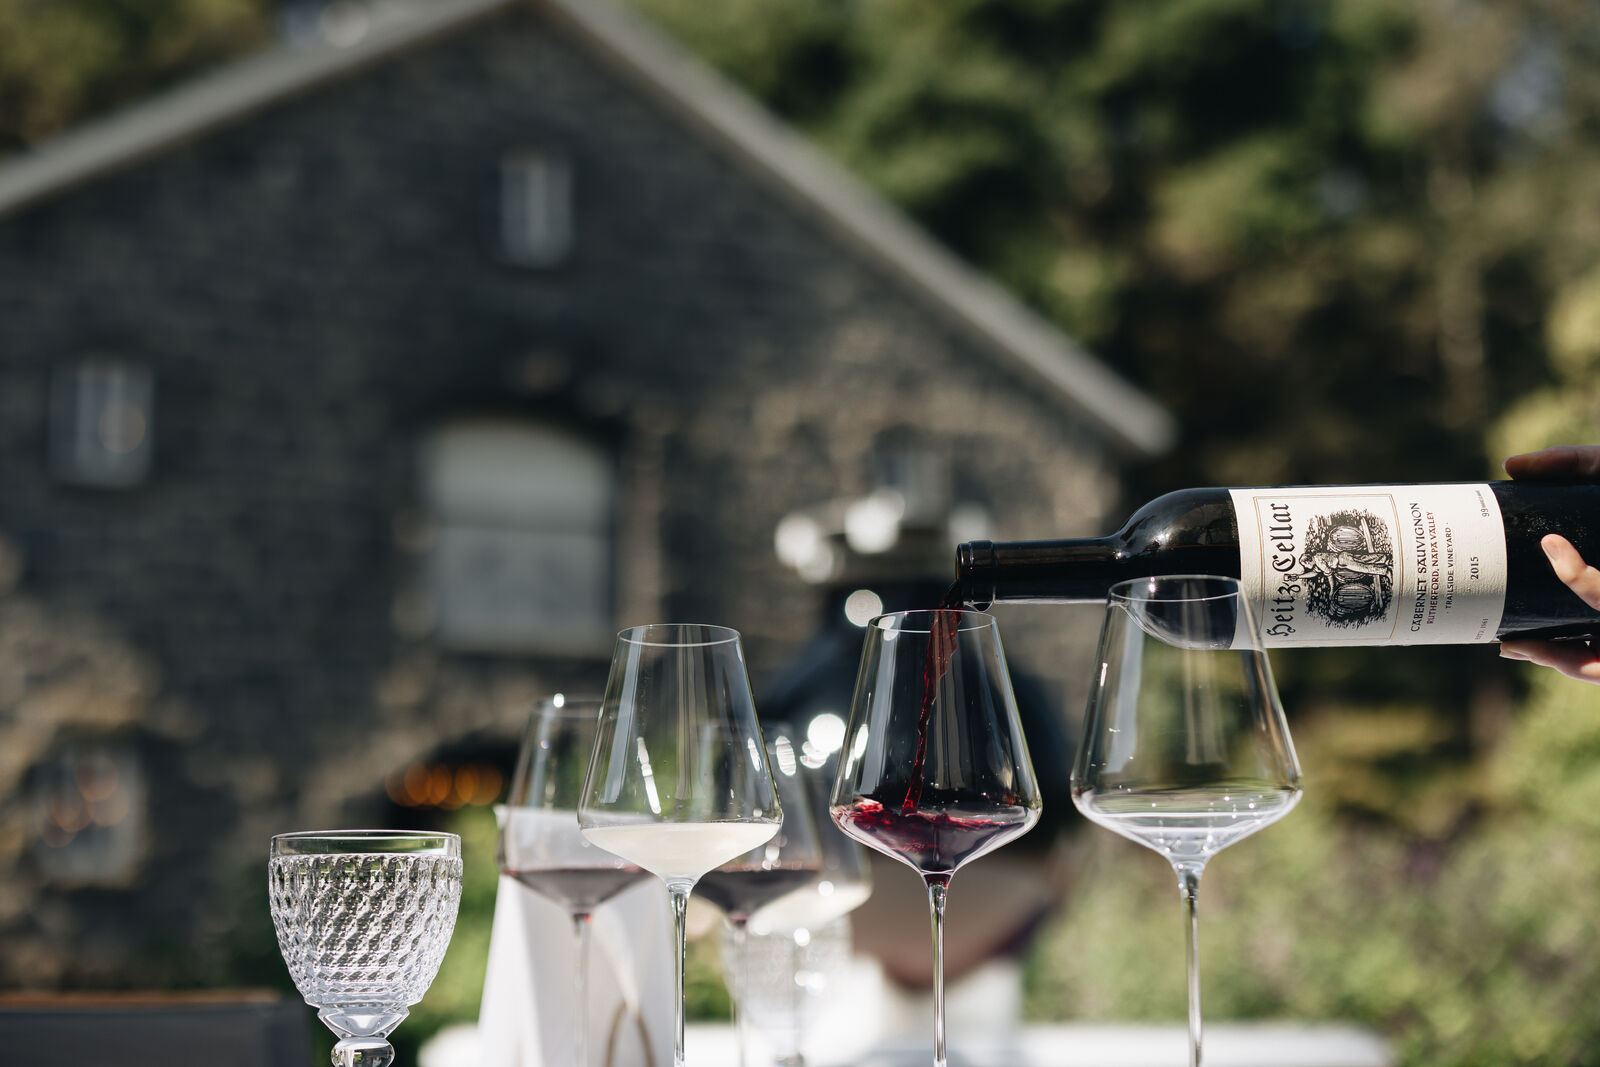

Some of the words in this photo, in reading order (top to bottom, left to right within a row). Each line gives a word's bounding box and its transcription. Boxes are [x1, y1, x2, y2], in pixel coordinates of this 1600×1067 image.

[1269, 503, 1296, 572] Cellar
[1409, 502, 1427, 574] SAUVIGNON
[1426, 511, 1438, 541] VALLEY
[1430, 541, 1439, 566] NAPA
[1445, 527, 1454, 567] VINEYARD
[1470, 556, 1479, 580] 2015
[1266, 582, 1301, 636] Heitz
[1410, 578, 1427, 632] CABERNET
[1445, 570, 1454, 609] TRAILSIDE
